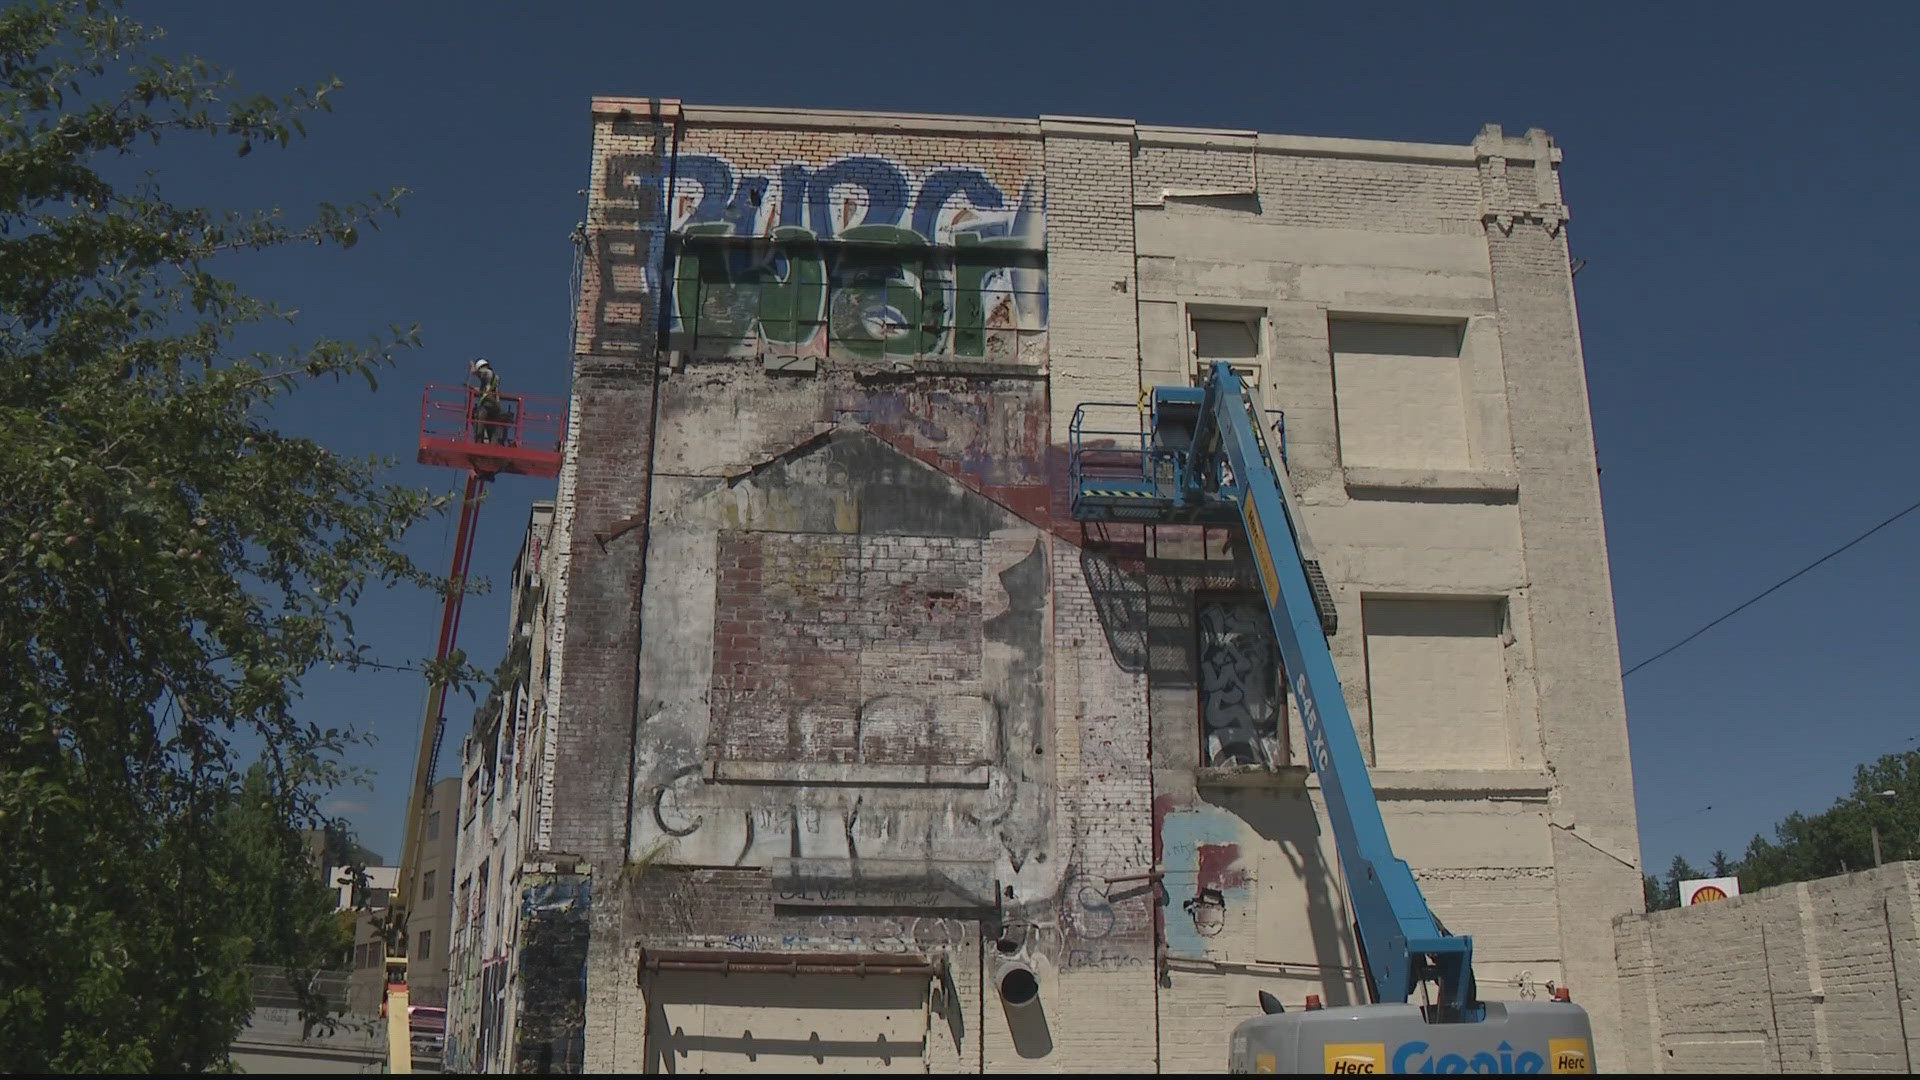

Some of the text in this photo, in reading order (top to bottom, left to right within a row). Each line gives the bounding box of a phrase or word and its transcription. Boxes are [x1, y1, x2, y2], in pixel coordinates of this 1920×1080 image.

[1296, 673, 1329, 772] S-45 XC
[1334, 1061, 1374, 1074] Herc
[1392, 1040, 1545, 1074] Genie
[1558, 1055, 1585, 1070] Herc
